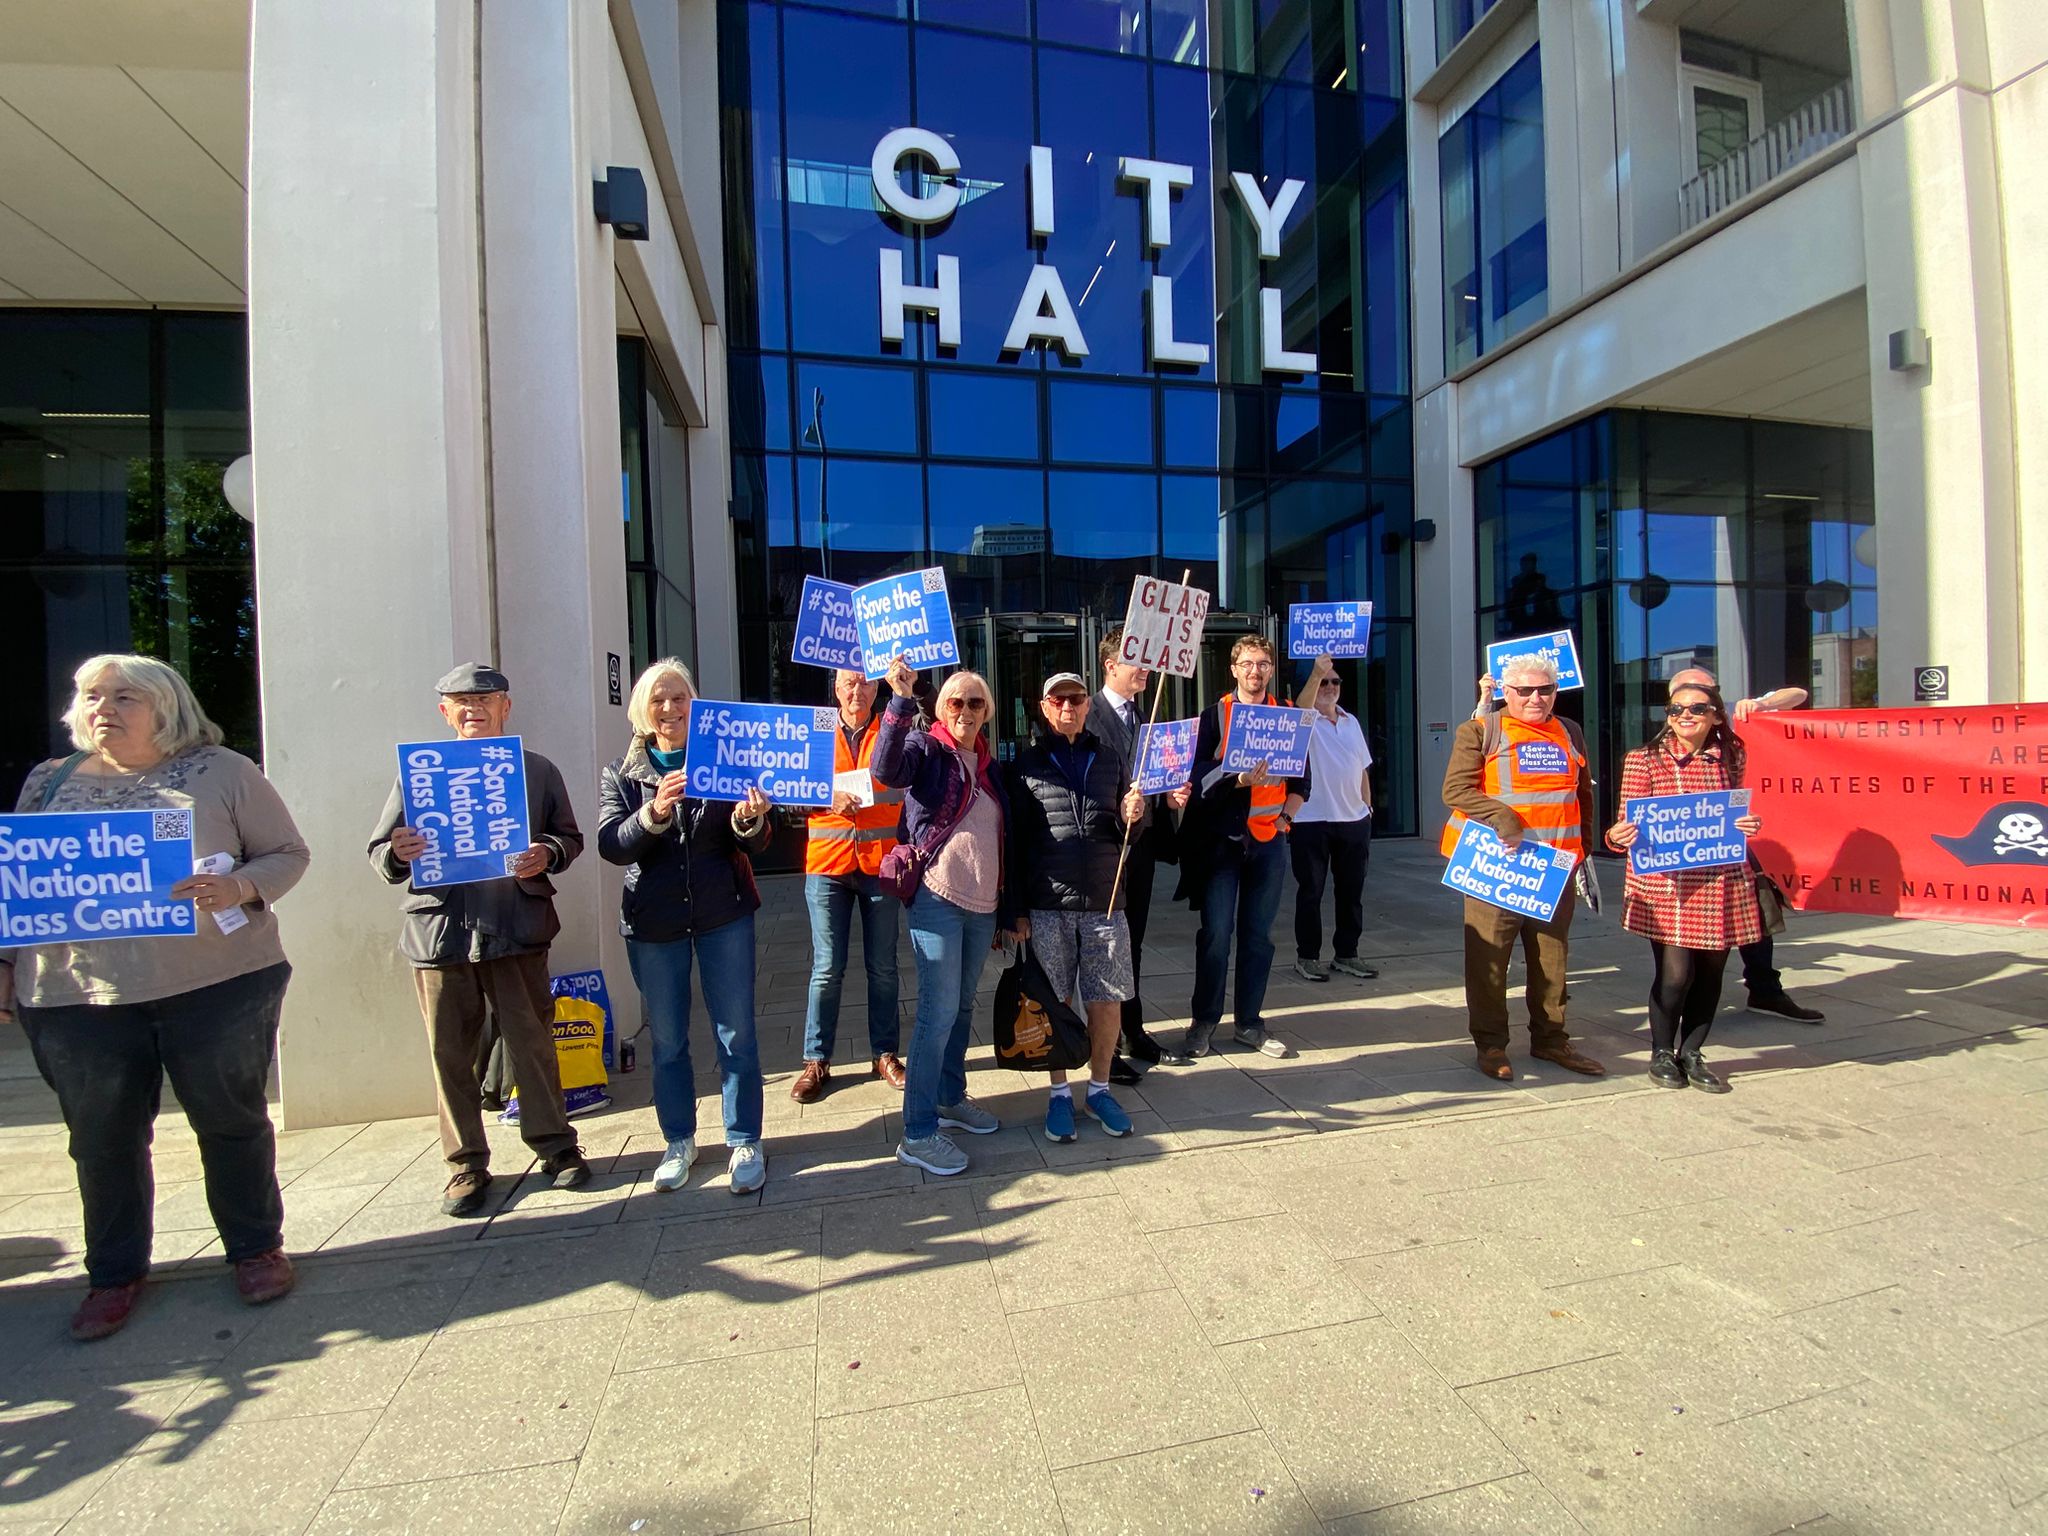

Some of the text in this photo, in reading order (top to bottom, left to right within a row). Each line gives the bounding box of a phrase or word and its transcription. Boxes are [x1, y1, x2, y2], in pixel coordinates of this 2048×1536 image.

[872, 127, 1305, 261] CITY
[880, 248, 1317, 373] HALL
[808, 588, 855, 619] #Sav
[856, 583, 922, 623] #Save the
[1141, 581, 1208, 620] GLASS
[1294, 606, 1355, 624] #Save the
[819, 615, 860, 644] Nati
[866, 607, 929, 645] National
[1166, 617, 1192, 643] IS
[1303, 622, 1356, 639] National
[800, 635, 846, 664] Glass
[864, 649, 891, 674] Glass
[1122, 635, 1193, 673] CLASS
[1292, 639, 1365, 655] Glass Centre
[698, 708, 809, 742] #Save the
[1236, 710, 1297, 732] #Save the
[1784, 715, 2028, 740] UNIVERSITY OF
[1177, 726, 1191, 746] the
[1244, 730, 1296, 752] National
[1521, 745, 1547, 753] #Save
[716, 738, 810, 770] National
[1149, 744, 1191, 770] National
[1264, 751, 1303, 772] Centre
[1519, 758, 1567, 766] Glass Centre
[1989, 745, 2048, 765] ARE
[693, 766, 830, 799] Glass Centre
[1761, 776, 2016, 795] PIRATES OF THE
[447, 767, 489, 858] National
[481, 746, 521, 851] #Save the
[1633, 797, 1725, 825] #Save the
[408, 749, 450, 882] Glass Centre
[0, 822, 146, 862] Save the
[1649, 817, 1726, 845] National
[1464, 828, 1548, 872] #Save the
[1635, 842, 1743, 870] Glass Centre
[0, 858, 152, 900] National
[1470, 851, 1546, 892] National
[1831, 876, 1882, 895] THE
[1450, 865, 1552, 915] Glass Centre
[1, 903, 68, 938] lass
[73, 899, 190, 932] Centre
